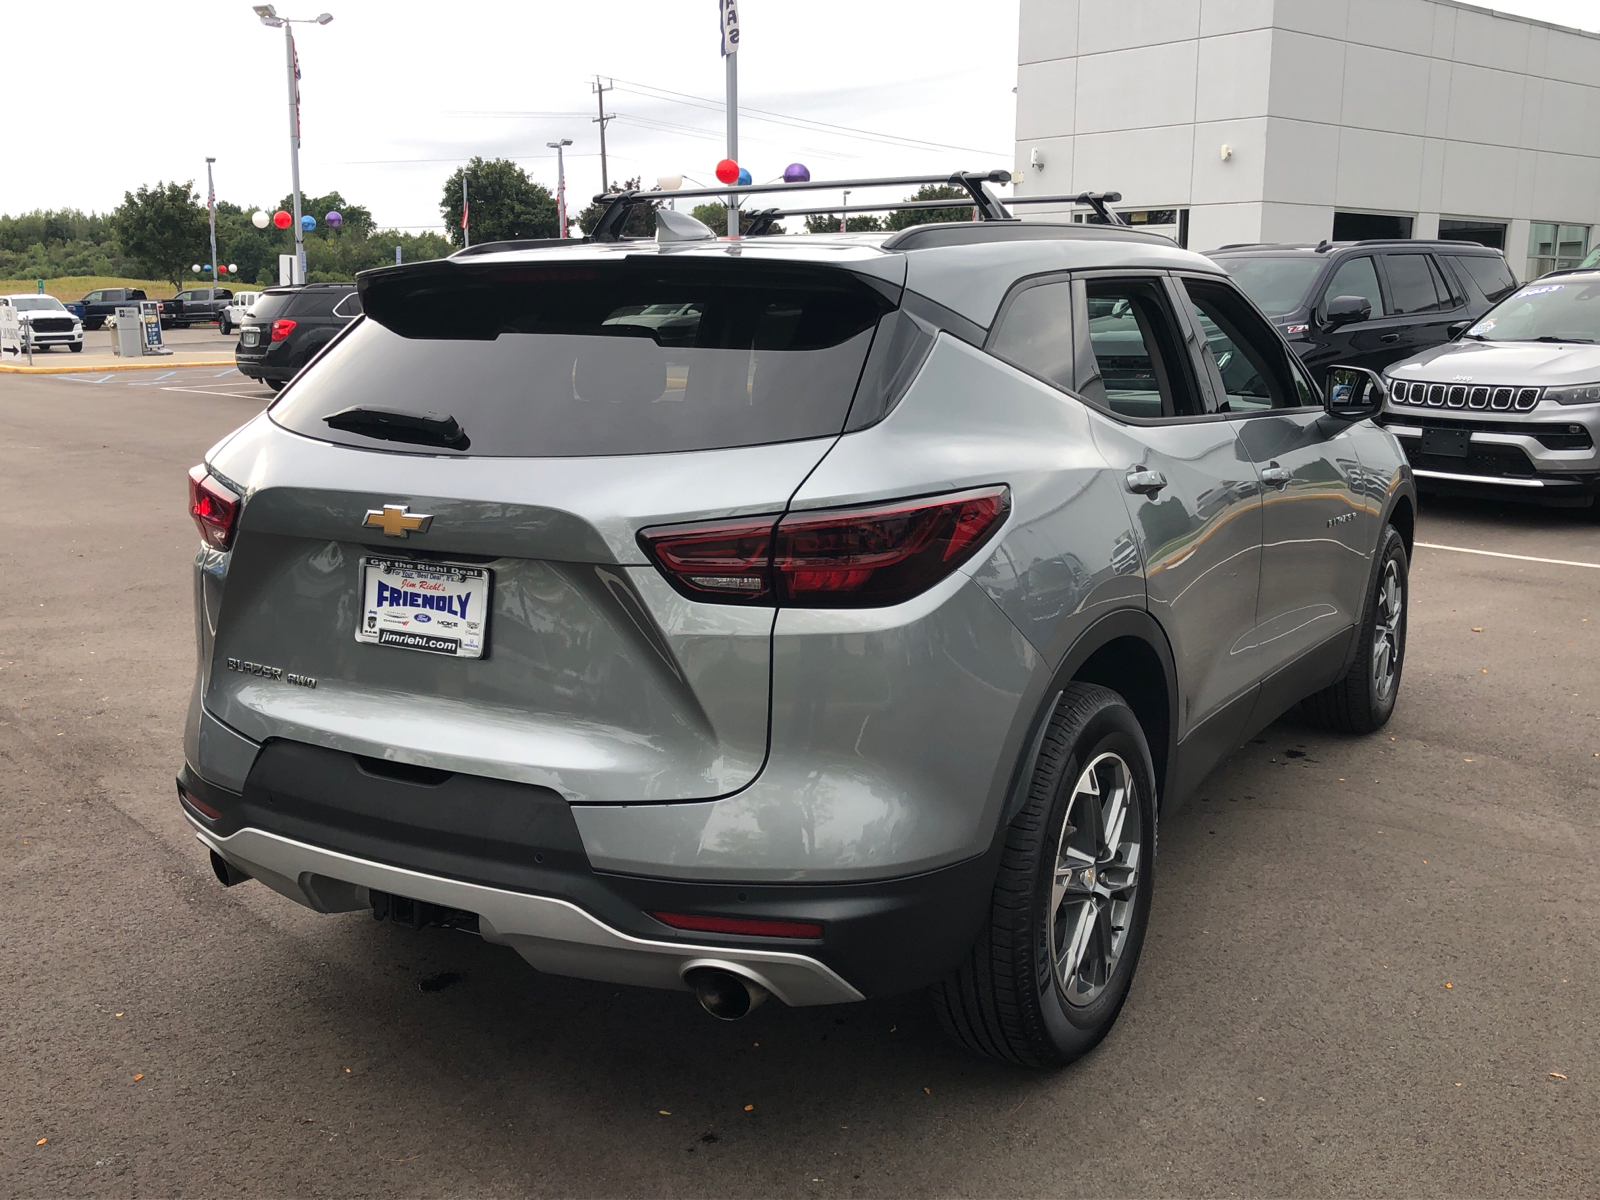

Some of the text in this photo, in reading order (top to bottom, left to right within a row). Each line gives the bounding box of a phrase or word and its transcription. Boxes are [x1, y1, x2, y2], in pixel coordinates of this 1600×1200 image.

[1287, 324, 1309, 333] Z71
[1452, 374, 1473, 382] Jeep
[417, 564, 447, 573] Riehl
[451, 567, 478, 576] Deal
[400, 578, 446, 591] Jim Riehl's
[376, 579, 472, 620] FRIENDLY
[380, 631, 456, 651] jimriehl.com
[227, 657, 318, 689] BLAZER AWD
